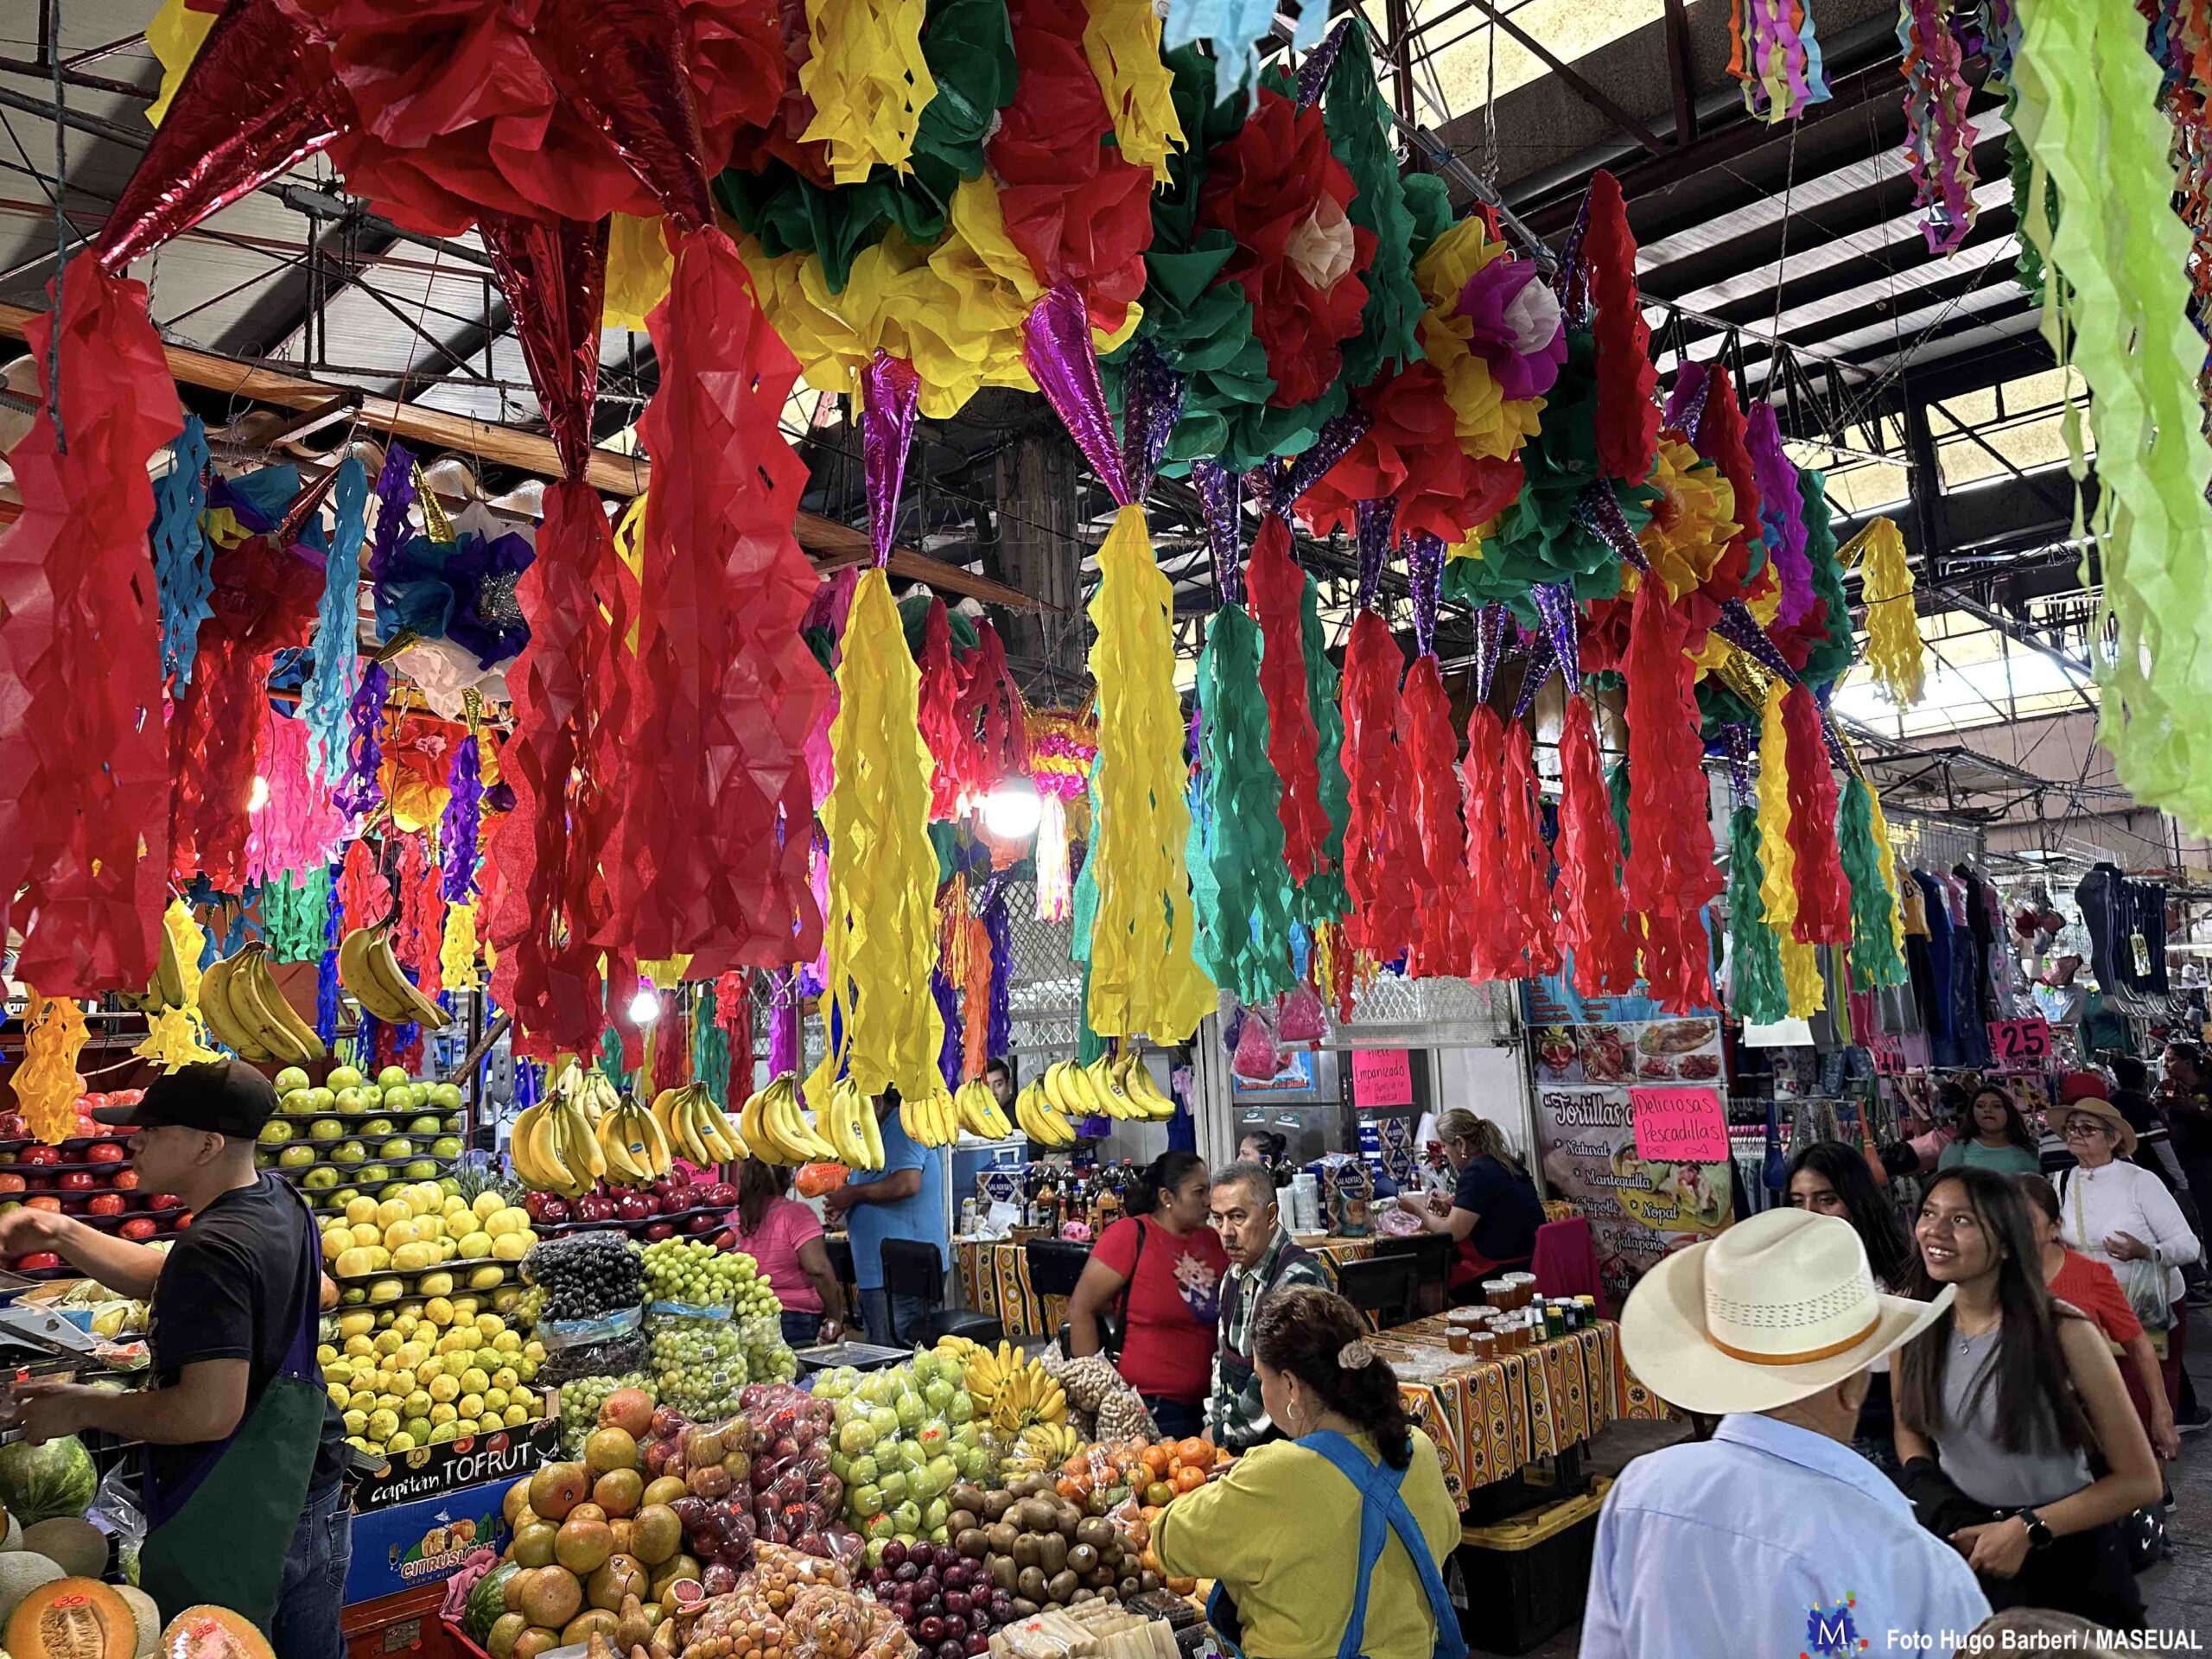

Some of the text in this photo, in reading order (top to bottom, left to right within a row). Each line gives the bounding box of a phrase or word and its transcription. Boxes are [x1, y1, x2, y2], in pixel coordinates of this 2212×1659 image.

[2000, 1023, 2044, 1058] 25
[1354, 1058, 1405, 1084] Empanizado
[1642, 1119, 1726, 1145] Pescadillas!
[1567, 1141, 1611, 1157] Natural
[987, 1183, 1014, 1192] SALADITAS
[1335, 1174, 1363, 1187] SALADITAS
[1585, 1168, 1652, 1193] Mantequilla
[1642, 1201, 1680, 1225] Nopal
[1614, 1230, 1666, 1255] Jalapeño
[442, 1441, 532, 1484] TOFRUT
[60, 1595, 84, 1606] 30
[195, 1624, 213, 1638] 35
